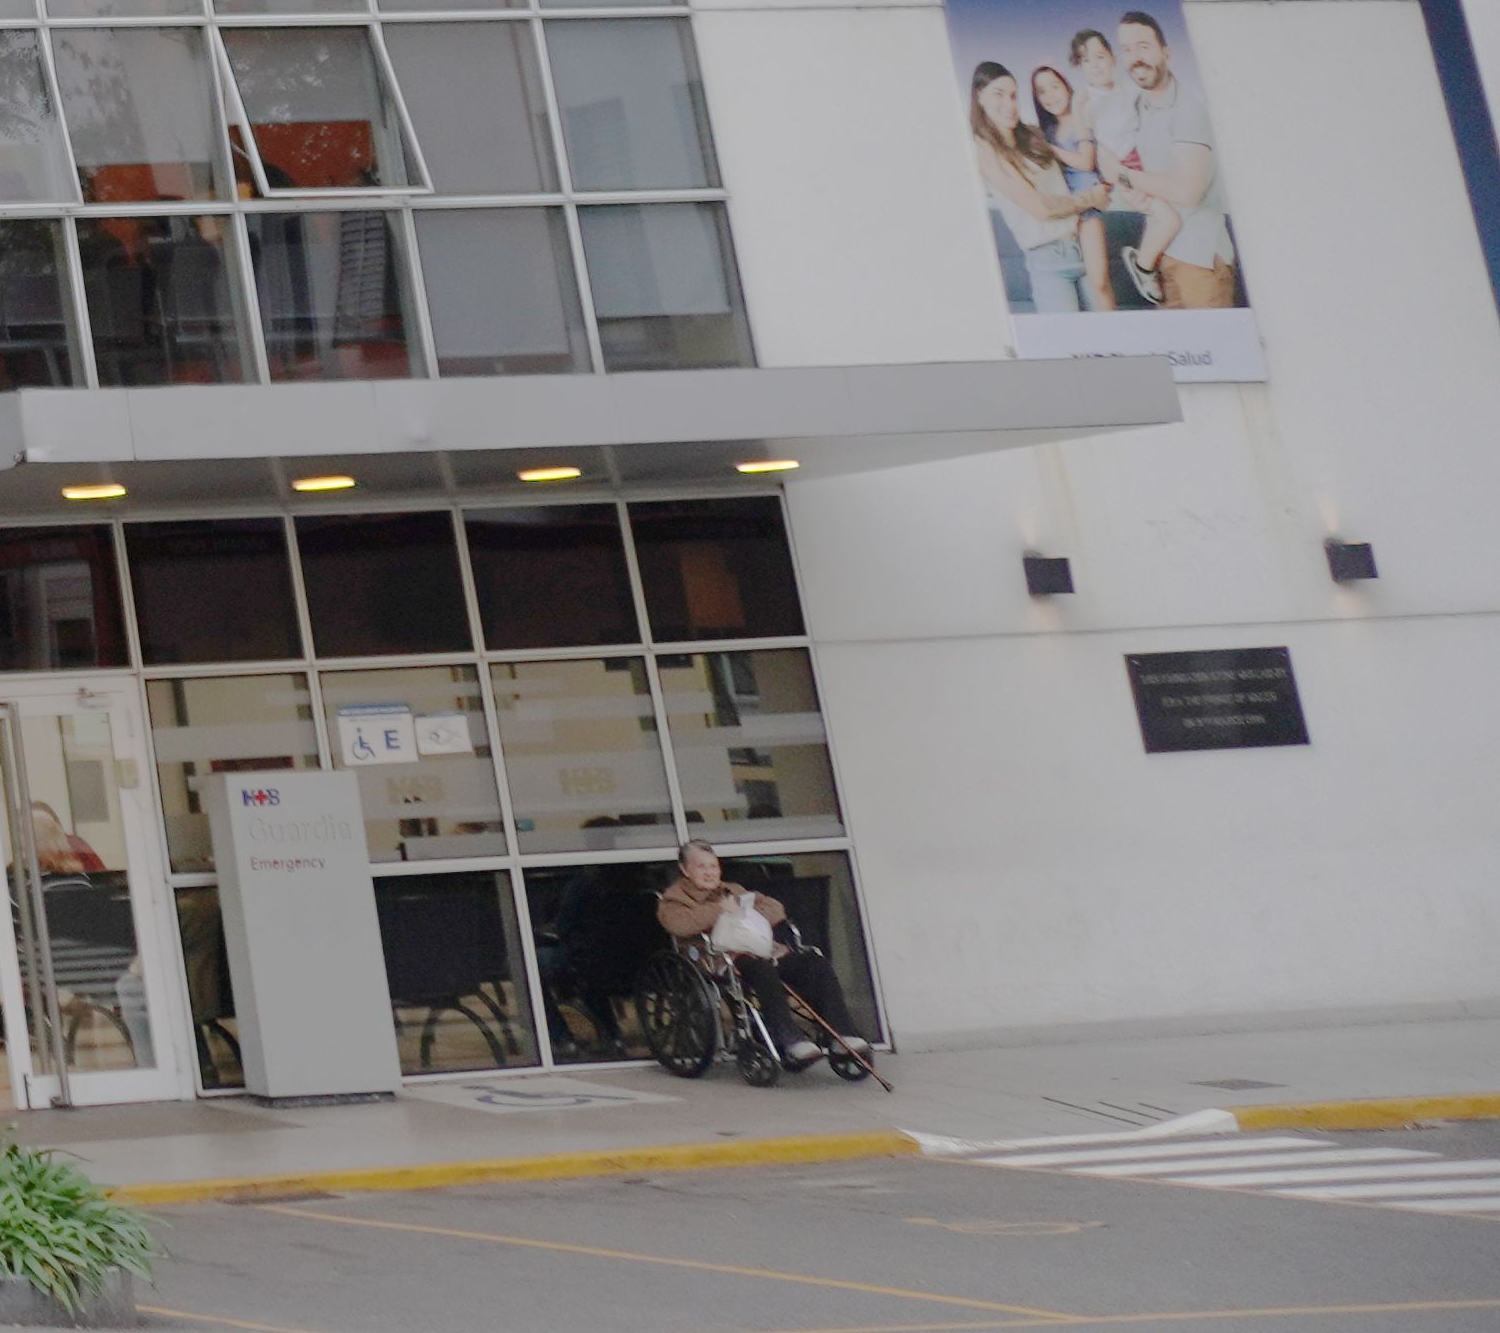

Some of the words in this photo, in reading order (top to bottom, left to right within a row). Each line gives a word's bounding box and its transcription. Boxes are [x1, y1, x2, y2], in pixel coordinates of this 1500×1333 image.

[1168, 350, 1212, 367] Salud
[384, 730, 401, 750] E
[250, 813, 353, 843] Guardia
[251, 856, 326, 874] Emergency
